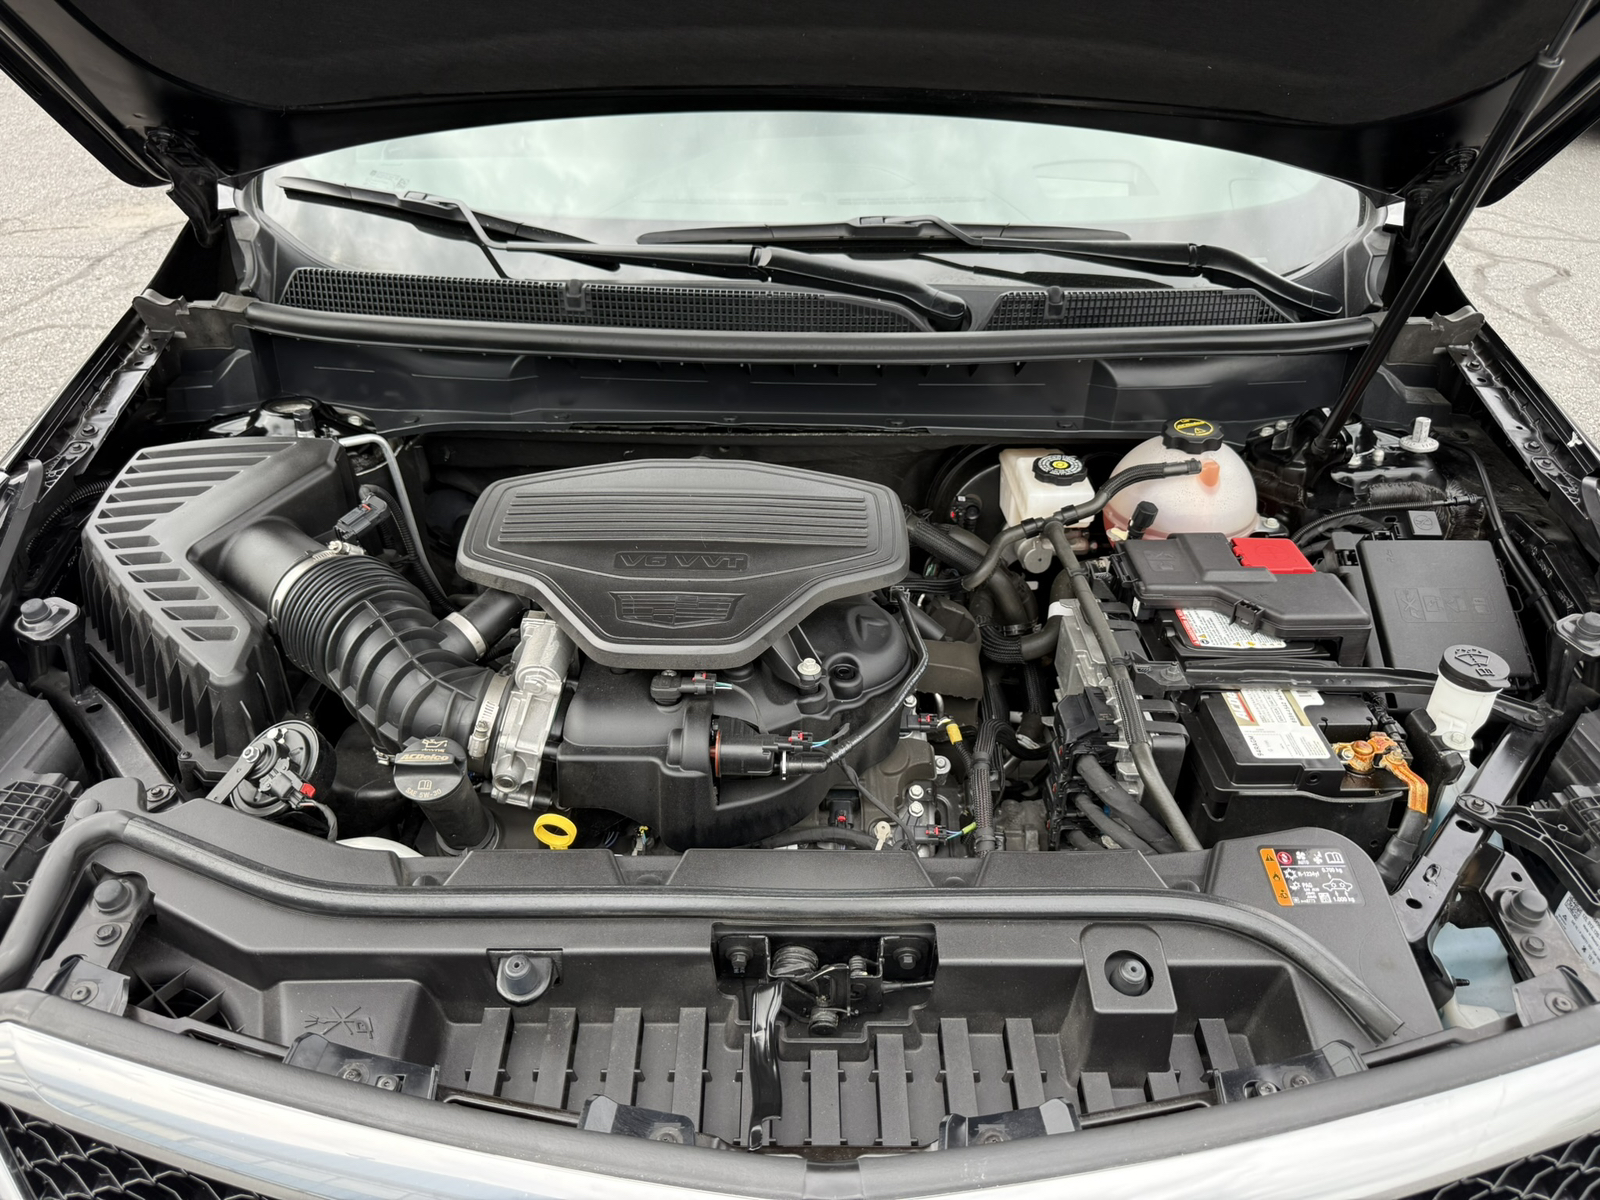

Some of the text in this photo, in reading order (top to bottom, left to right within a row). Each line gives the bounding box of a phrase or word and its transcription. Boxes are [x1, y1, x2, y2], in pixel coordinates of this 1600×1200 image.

[620, 554, 744, 568] V6 VVT
[399, 753, 449, 761] ACDelco
[405, 787, 442, 798] SAE 5W-30
